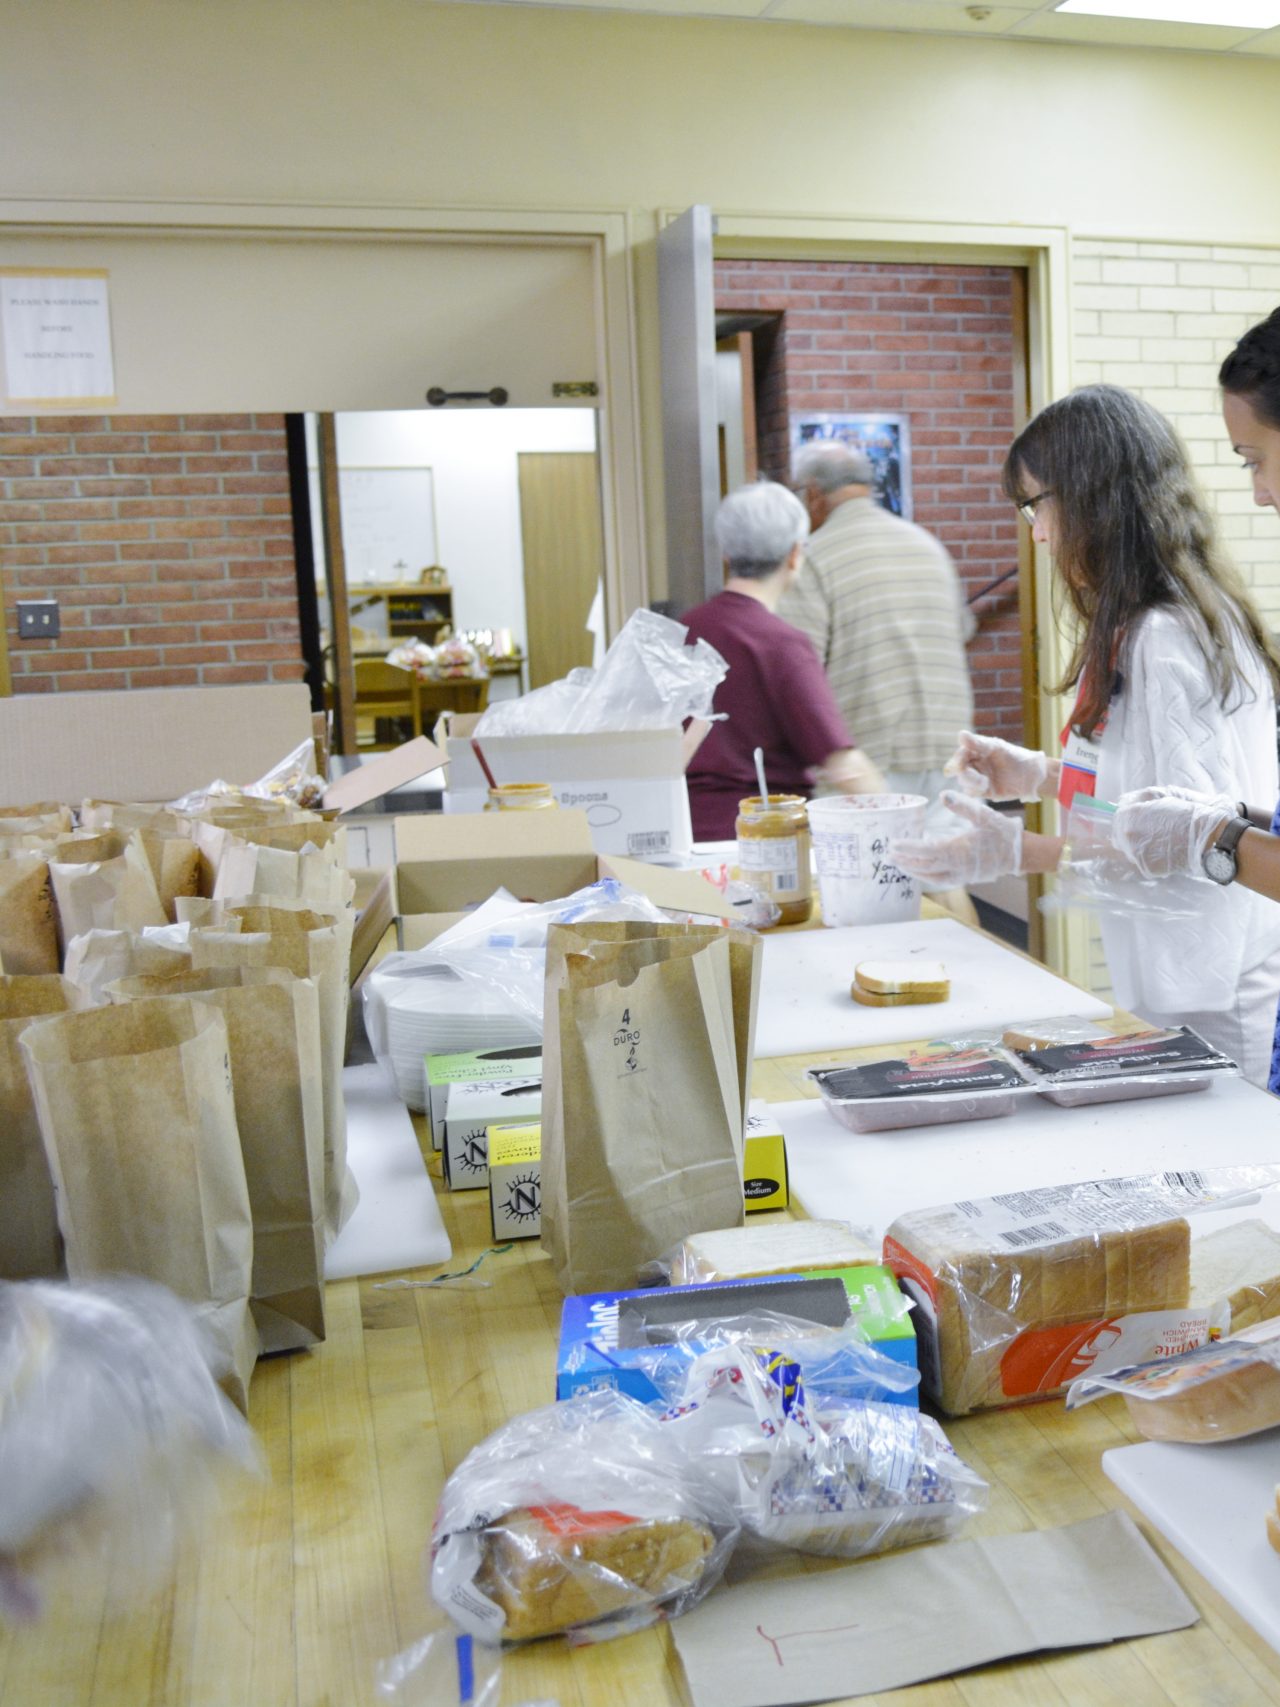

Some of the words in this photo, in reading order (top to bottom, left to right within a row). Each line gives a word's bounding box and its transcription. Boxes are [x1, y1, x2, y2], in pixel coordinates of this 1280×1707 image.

[561, 792, 609, 805] Spoons
[622, 1008, 631, 1025] 4
[613, 1030, 641, 1046] DURO
[516, 1187, 536, 1210] N
[744, 1187, 772, 1197] Medium
[1180, 1318, 1207, 1328] BREAD
[1154, 1338, 1199, 1356] White
